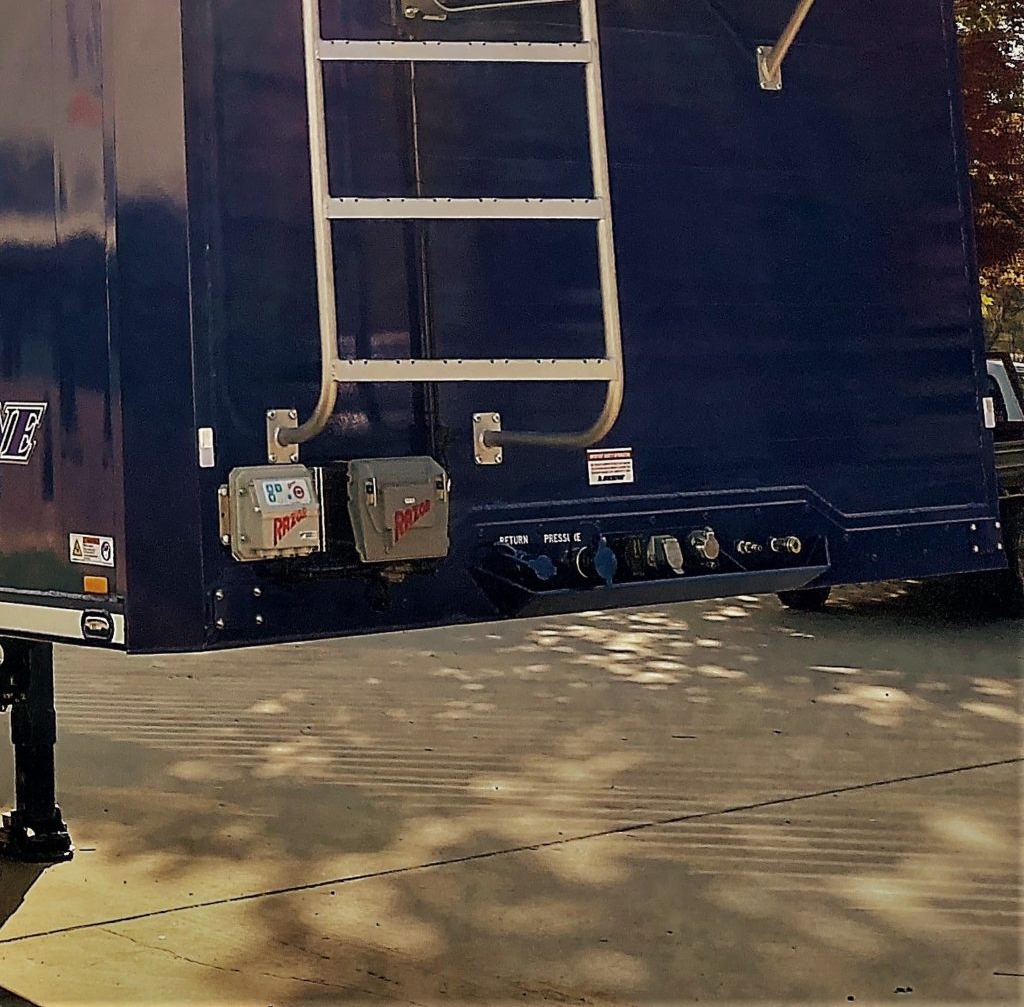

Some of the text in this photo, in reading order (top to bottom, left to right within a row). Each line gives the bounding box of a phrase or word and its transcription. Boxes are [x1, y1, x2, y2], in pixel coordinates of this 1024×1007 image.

[272, 507, 308, 547] RAZOR
[393, 499, 432, 544] RAZOR
[499, 534, 529, 545] RETURN
